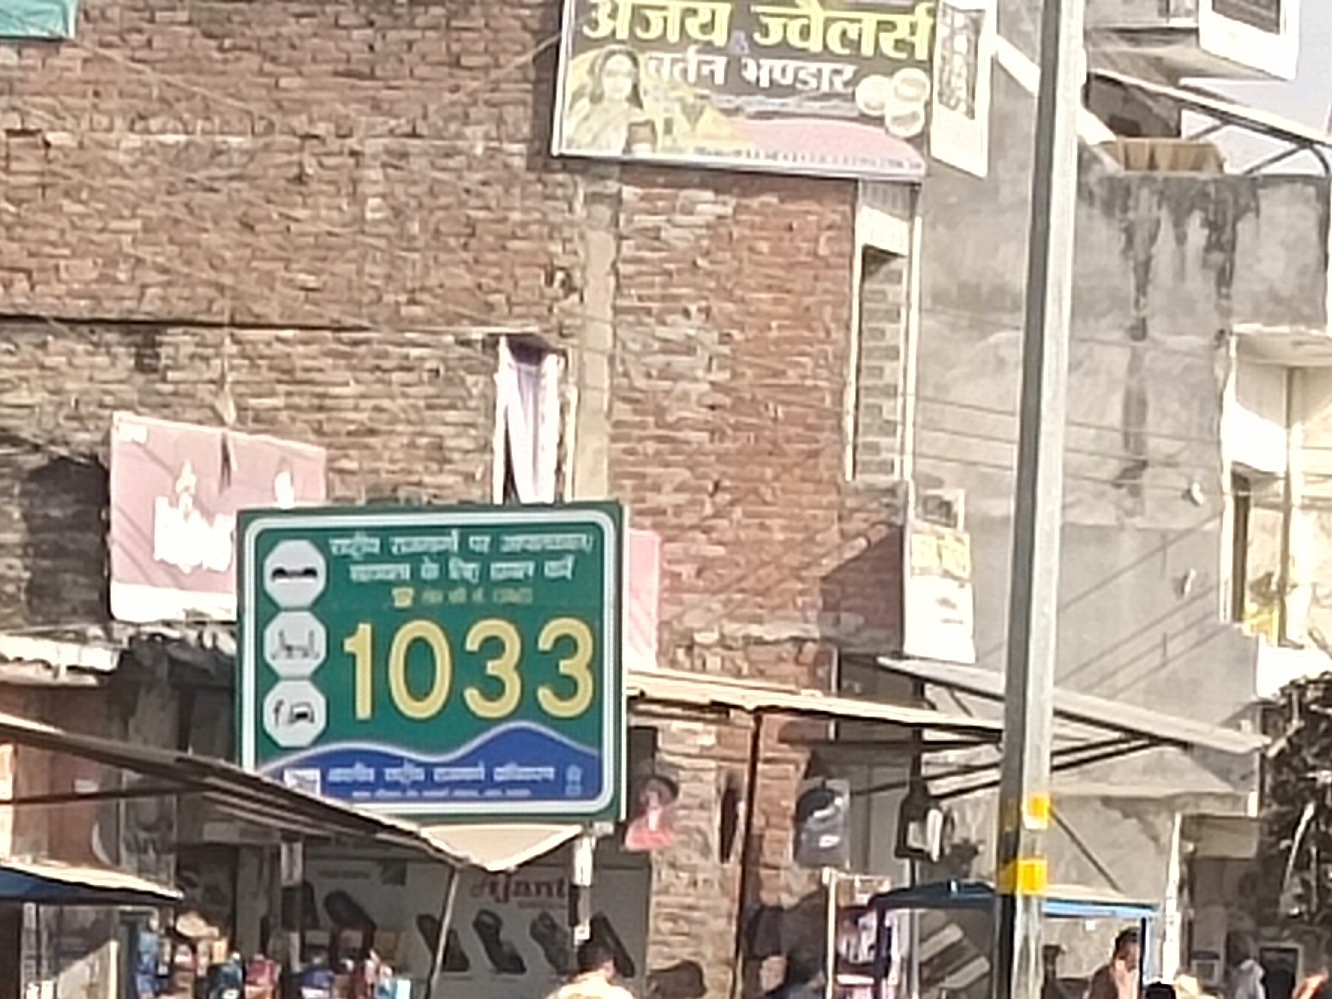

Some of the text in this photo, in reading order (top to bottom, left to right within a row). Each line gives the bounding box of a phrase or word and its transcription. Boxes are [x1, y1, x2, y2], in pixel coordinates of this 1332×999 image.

[582, 0, 731, 46] अजय
[741, 57, 858, 93] भण्डार
[343, 617, 594, 721] 1033
